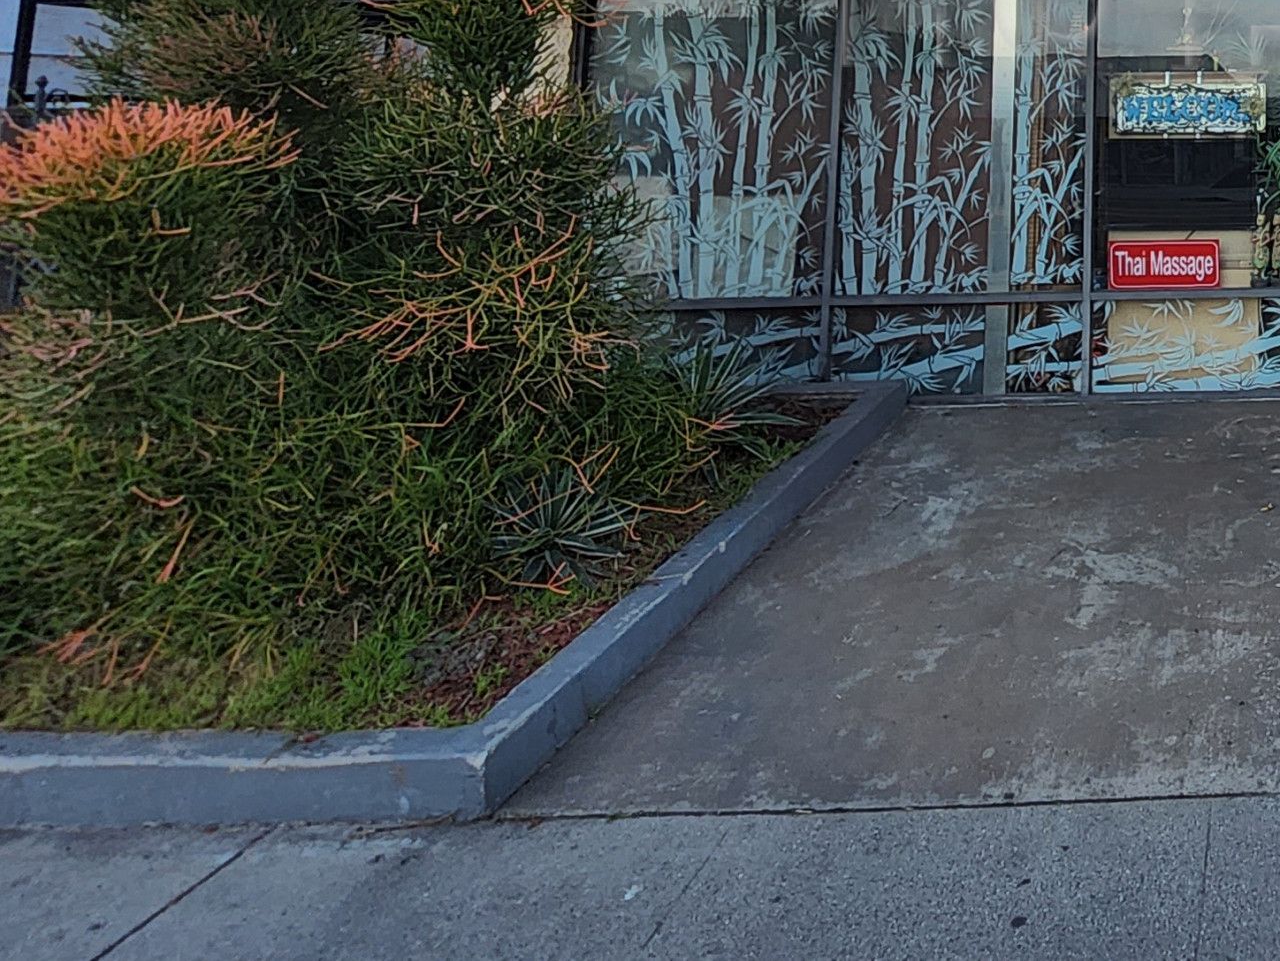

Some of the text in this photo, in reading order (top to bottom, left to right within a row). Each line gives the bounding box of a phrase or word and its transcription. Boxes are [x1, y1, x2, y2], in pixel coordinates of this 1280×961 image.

[1122, 94, 1253, 122] WELCOM
[1115, 251, 1214, 281] Thai Massage
